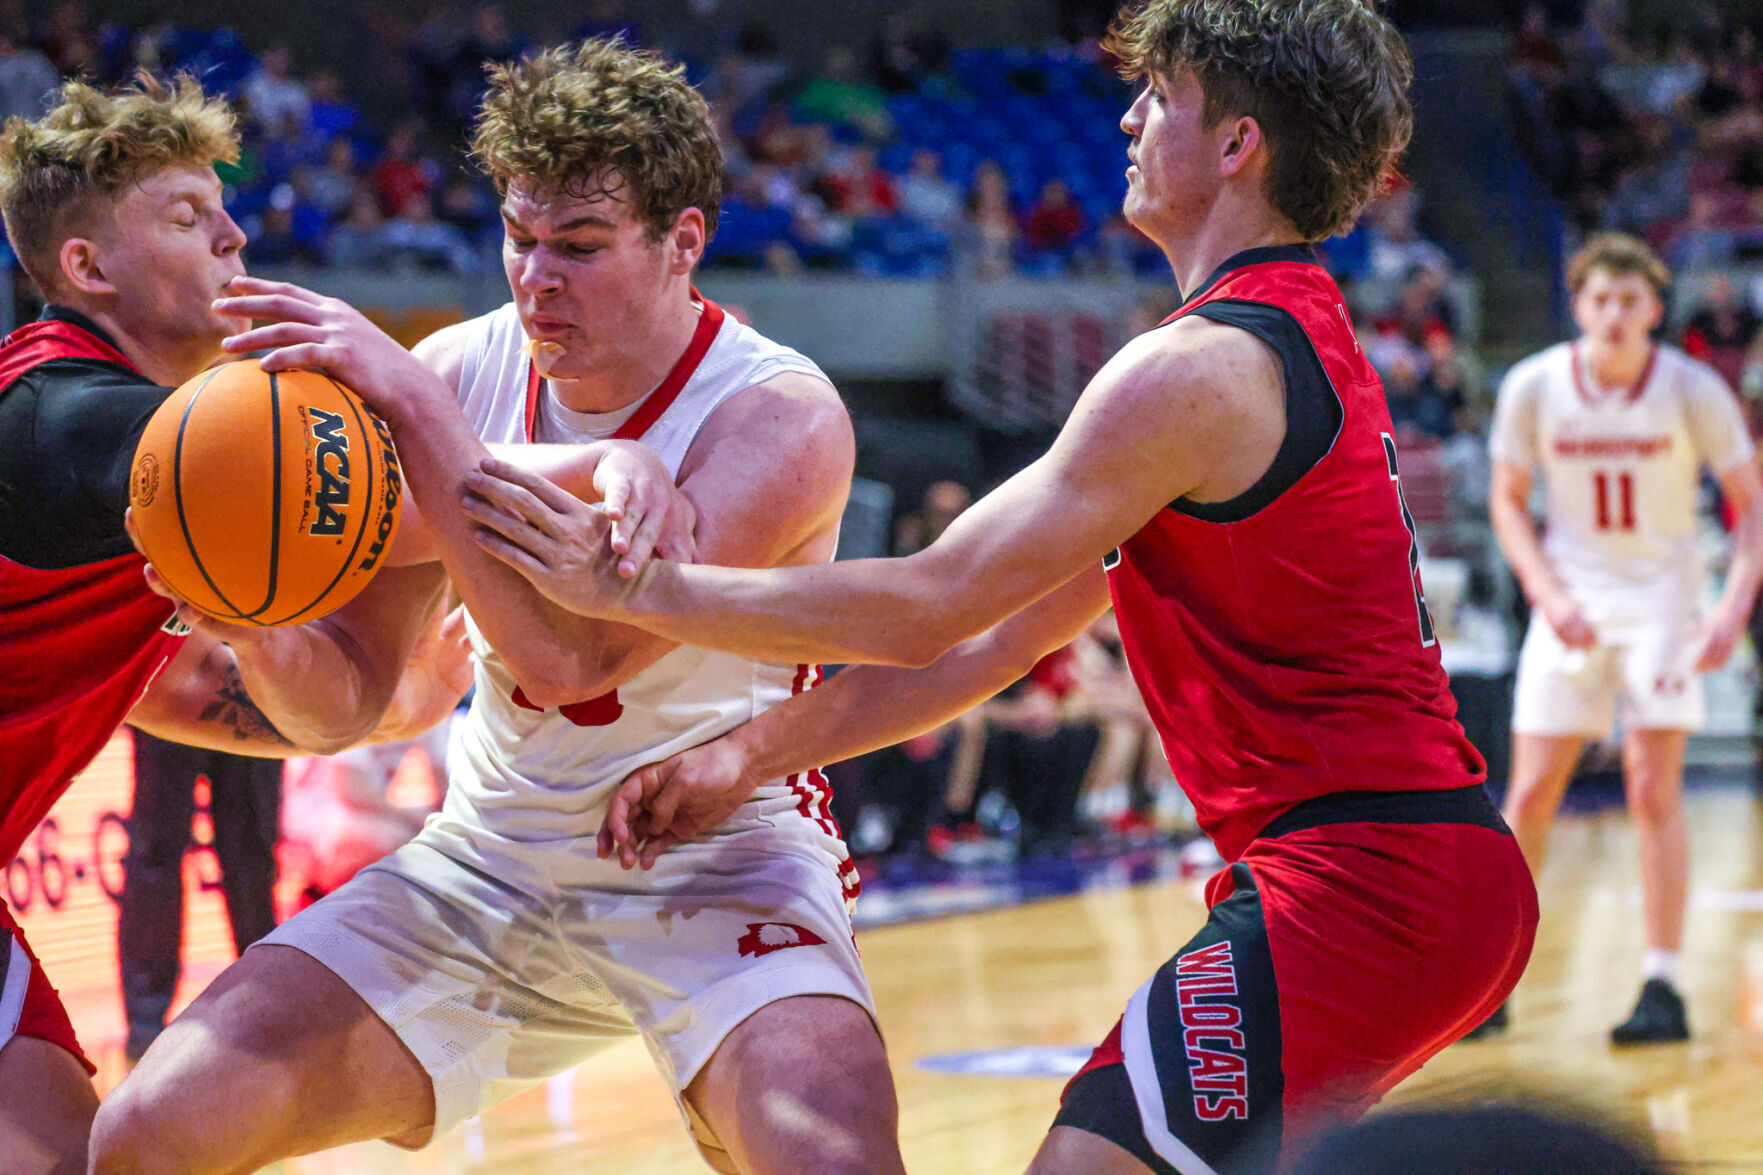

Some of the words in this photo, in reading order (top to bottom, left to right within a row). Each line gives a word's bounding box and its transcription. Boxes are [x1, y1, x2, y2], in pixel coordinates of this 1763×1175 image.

[297, 405, 313, 455] OFFICIAL
[305, 459, 313, 497] GAME
[307, 406, 351, 536] NCAA
[299, 500, 311, 535] BALL
[1595, 472, 1635, 532] 11
[1176, 940, 1249, 1121] WILDCATS
